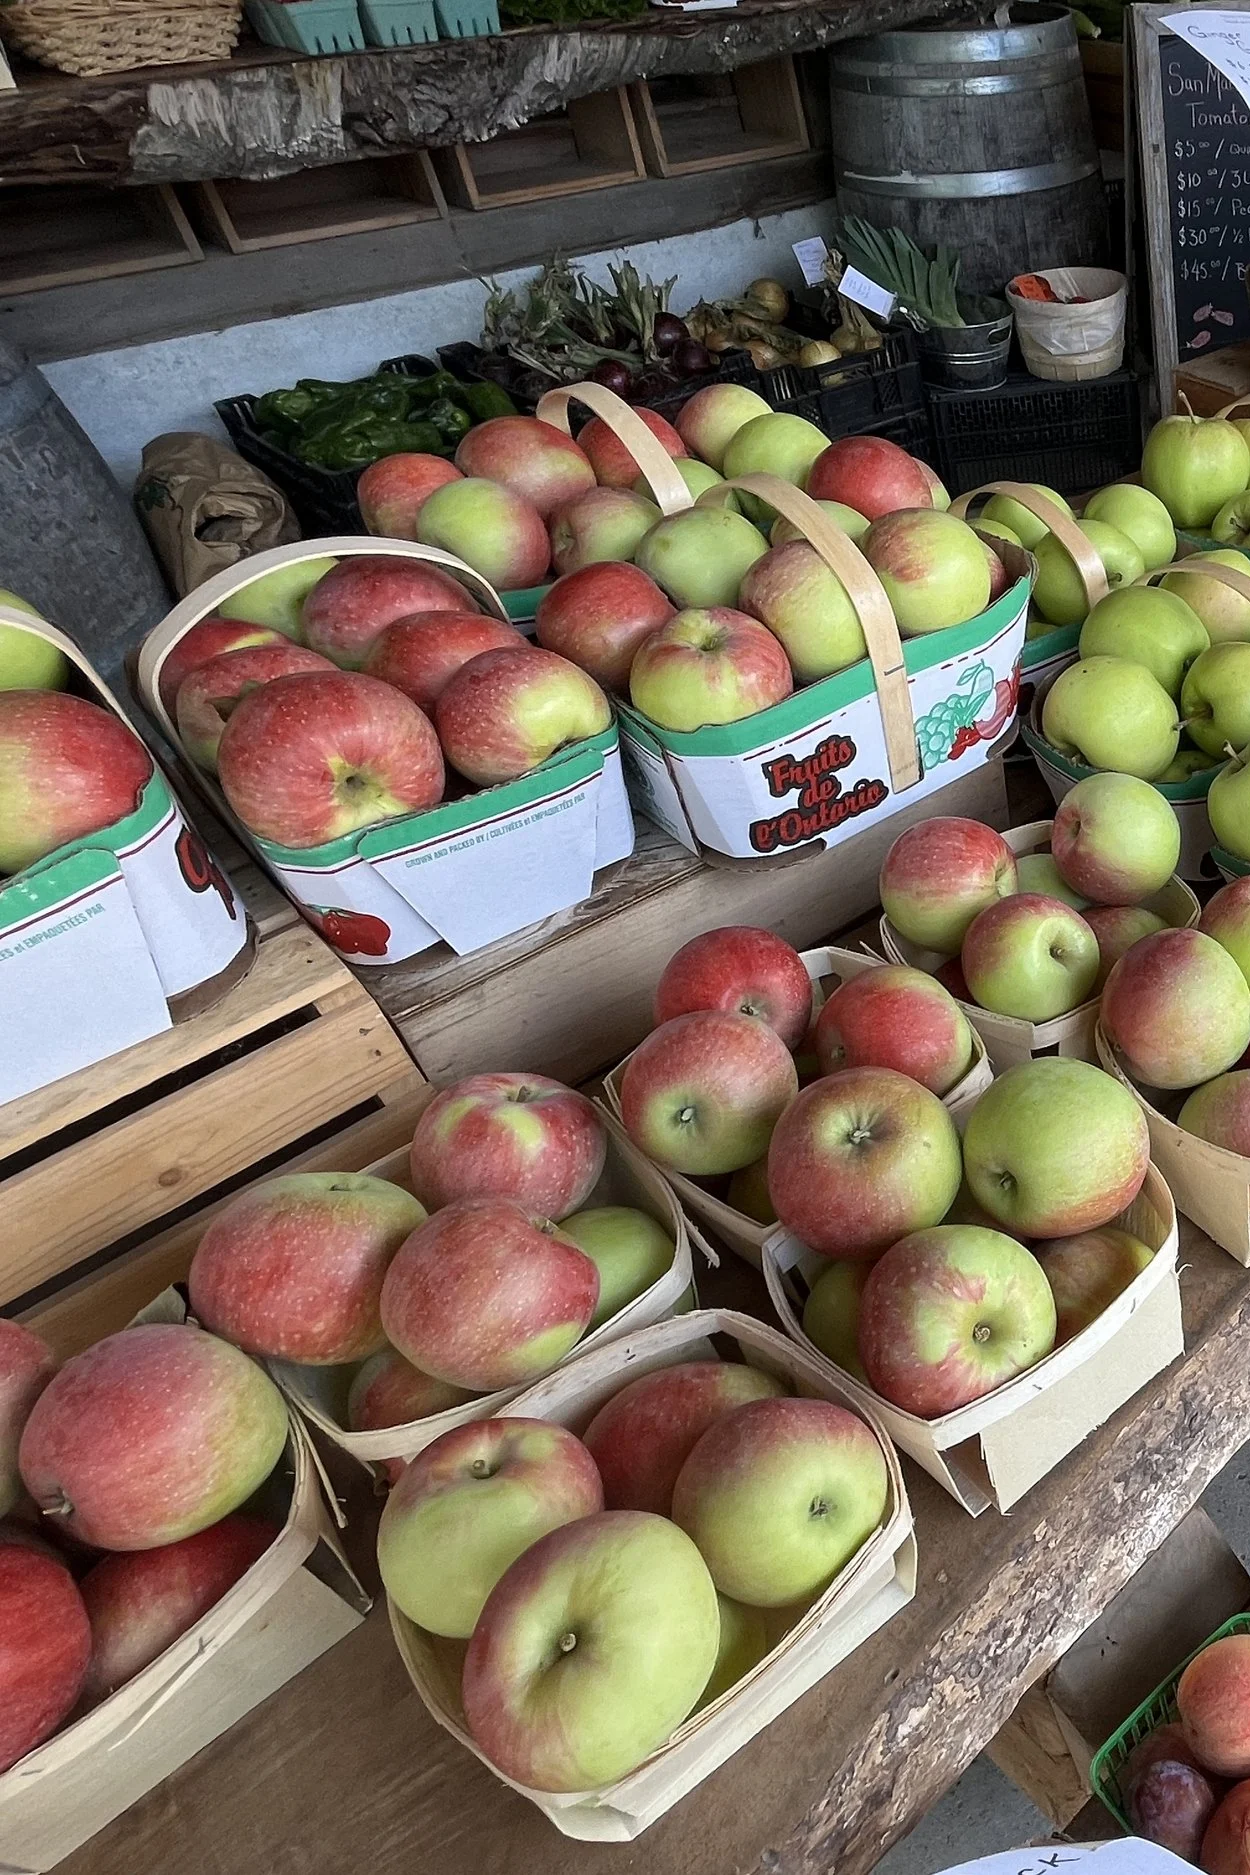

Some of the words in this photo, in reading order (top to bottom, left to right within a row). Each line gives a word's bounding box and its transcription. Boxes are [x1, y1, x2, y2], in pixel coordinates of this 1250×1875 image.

[1168, 62, 1204, 96] San
[763, 735, 856, 797] Fruits
[799, 775, 841, 809] de
[405, 853, 433, 868] GROWN
[433, 848, 448, 860] AND
[449, 838, 475, 854] PACKED
[475, 834, 485, 844] BY
[490, 819, 524, 838] CULTIVÉES
[574, 791, 586, 805] PAR
[23, 911, 87, 949] EMPAQUETÉES
[87, 903, 106, 921] PAR
